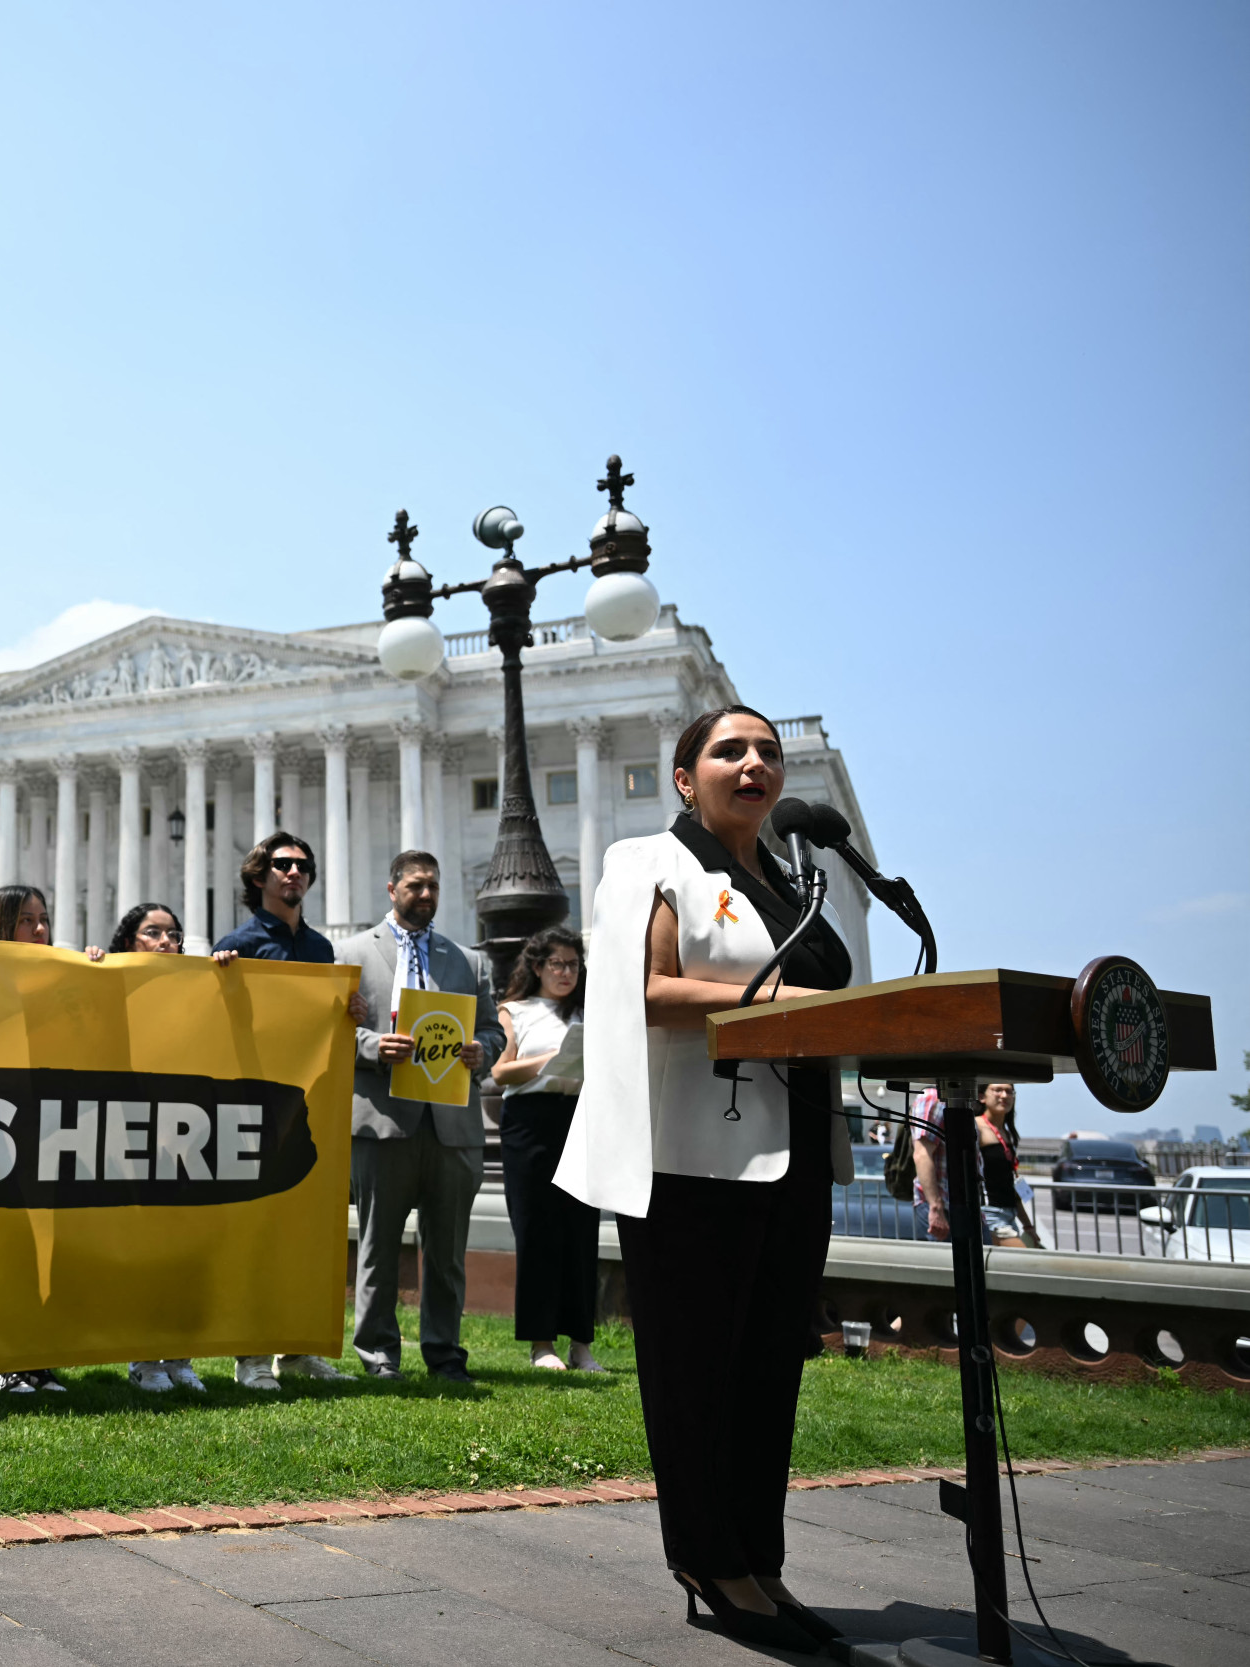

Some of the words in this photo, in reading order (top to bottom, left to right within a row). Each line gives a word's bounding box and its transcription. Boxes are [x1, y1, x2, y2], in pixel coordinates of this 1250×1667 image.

[1101, 970, 1150, 996] STATES
[415, 1036, 463, 1063] here
[426, 1023, 455, 1035] HOME
[1092, 1000, 1119, 1090] UNITED
[1147, 1006, 1167, 1092] SENATE
[37, 1100, 263, 1181] HERE
